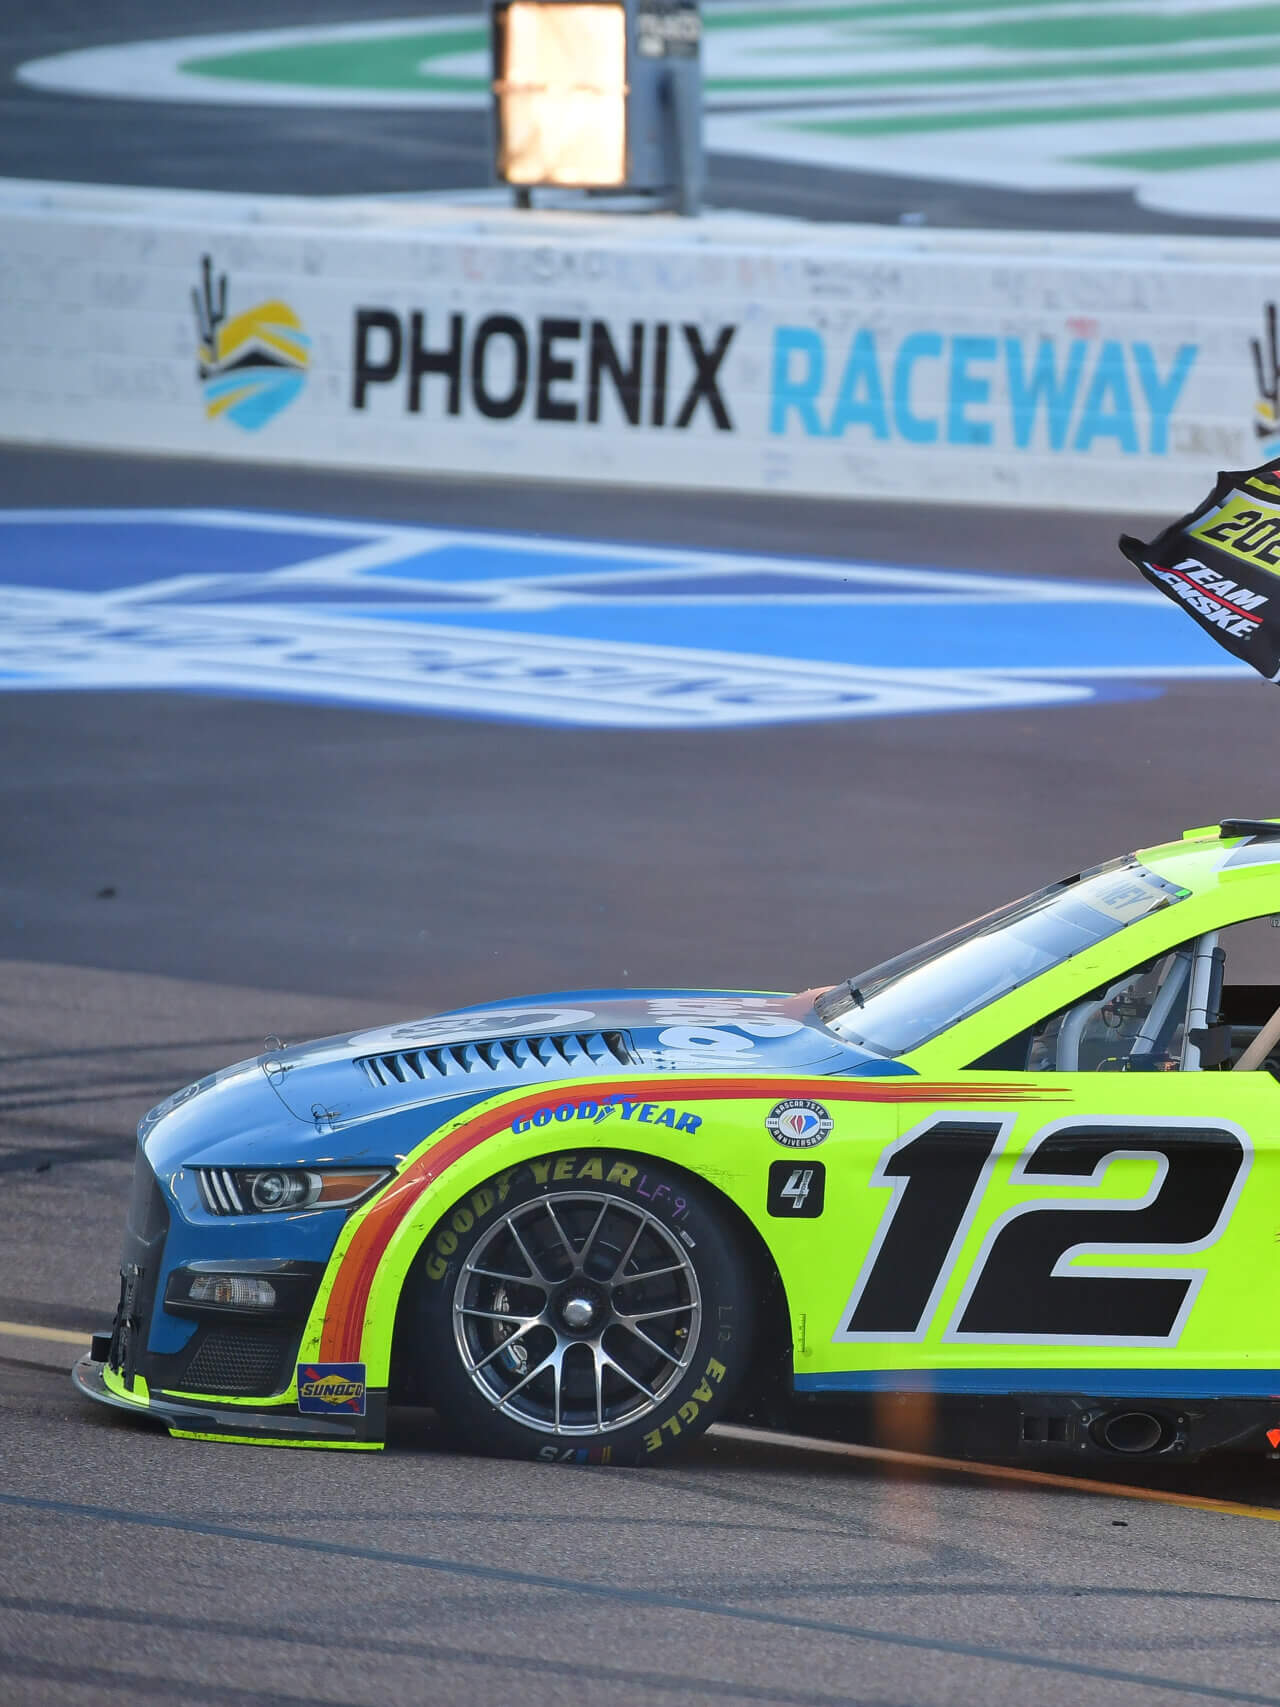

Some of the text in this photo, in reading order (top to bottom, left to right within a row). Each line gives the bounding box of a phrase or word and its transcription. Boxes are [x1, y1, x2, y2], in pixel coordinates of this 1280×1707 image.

[350, 307, 1198, 455] PHOENIX RACEWAY
[1172, 558, 1269, 611] TEAM
[775, 1101, 825, 1116] NASCAR 75TH
[773, 1129, 826, 1147] ANNIVERSARY
[780, 1169, 814, 1209] 4
[831, 1111, 1255, 1348] 12
[303, 1383, 364, 1396] SUNOCO
[643, 1358, 727, 1452] EAGLE
